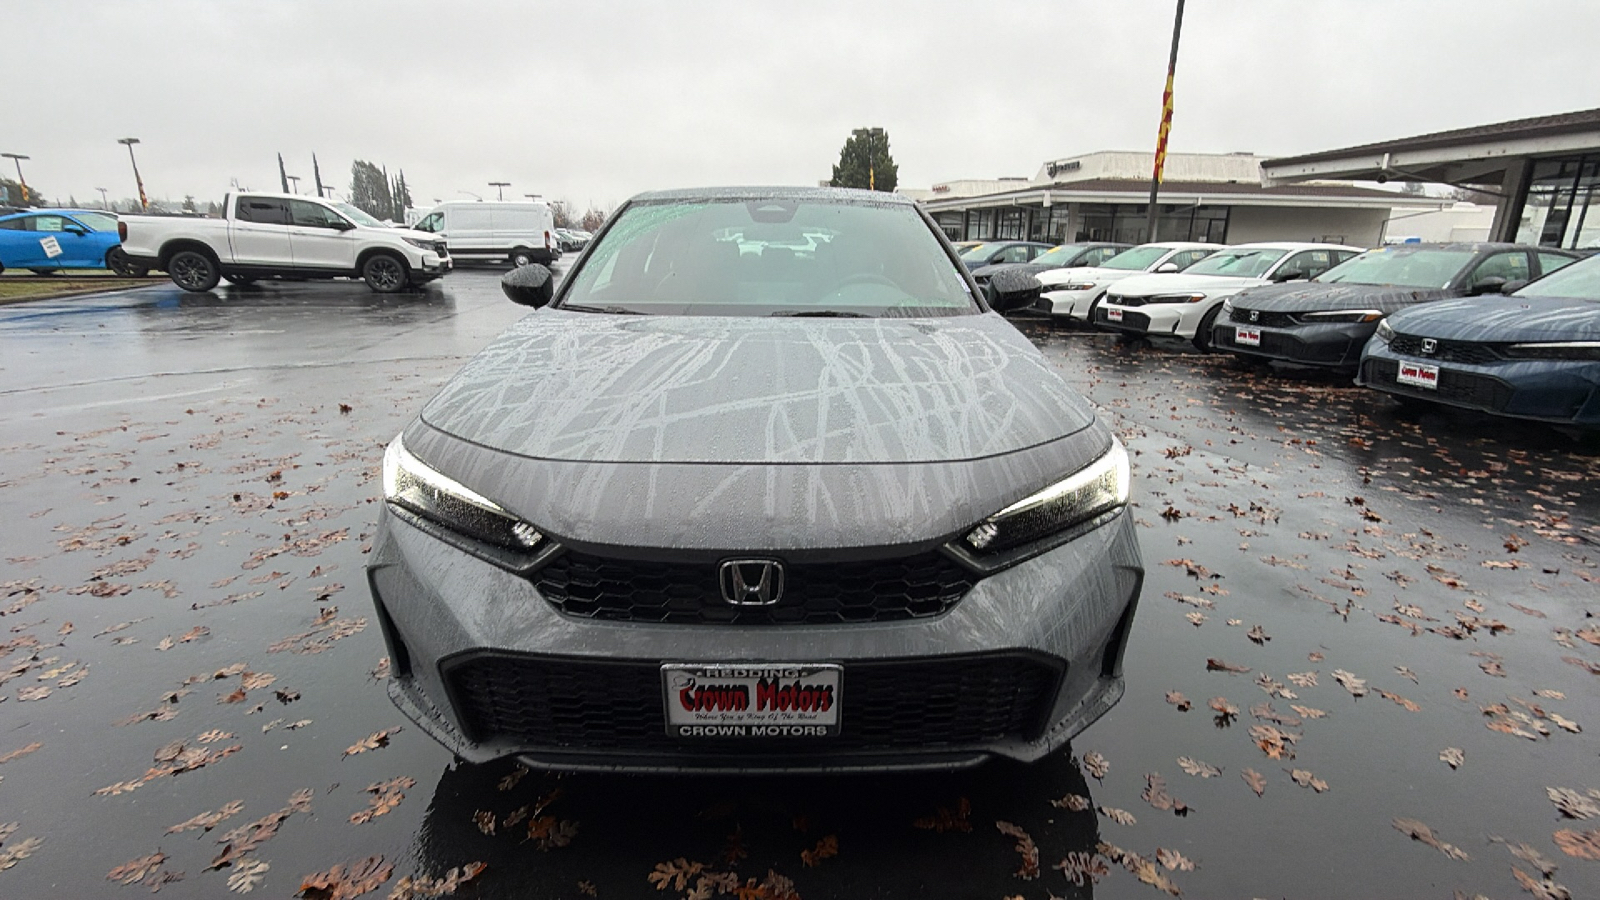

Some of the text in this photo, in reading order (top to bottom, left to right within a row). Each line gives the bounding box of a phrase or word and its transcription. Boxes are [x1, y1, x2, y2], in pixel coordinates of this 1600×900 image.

[679, 678, 834, 712] Crown Motors
[679, 725, 828, 736] CROWN MOTORS
